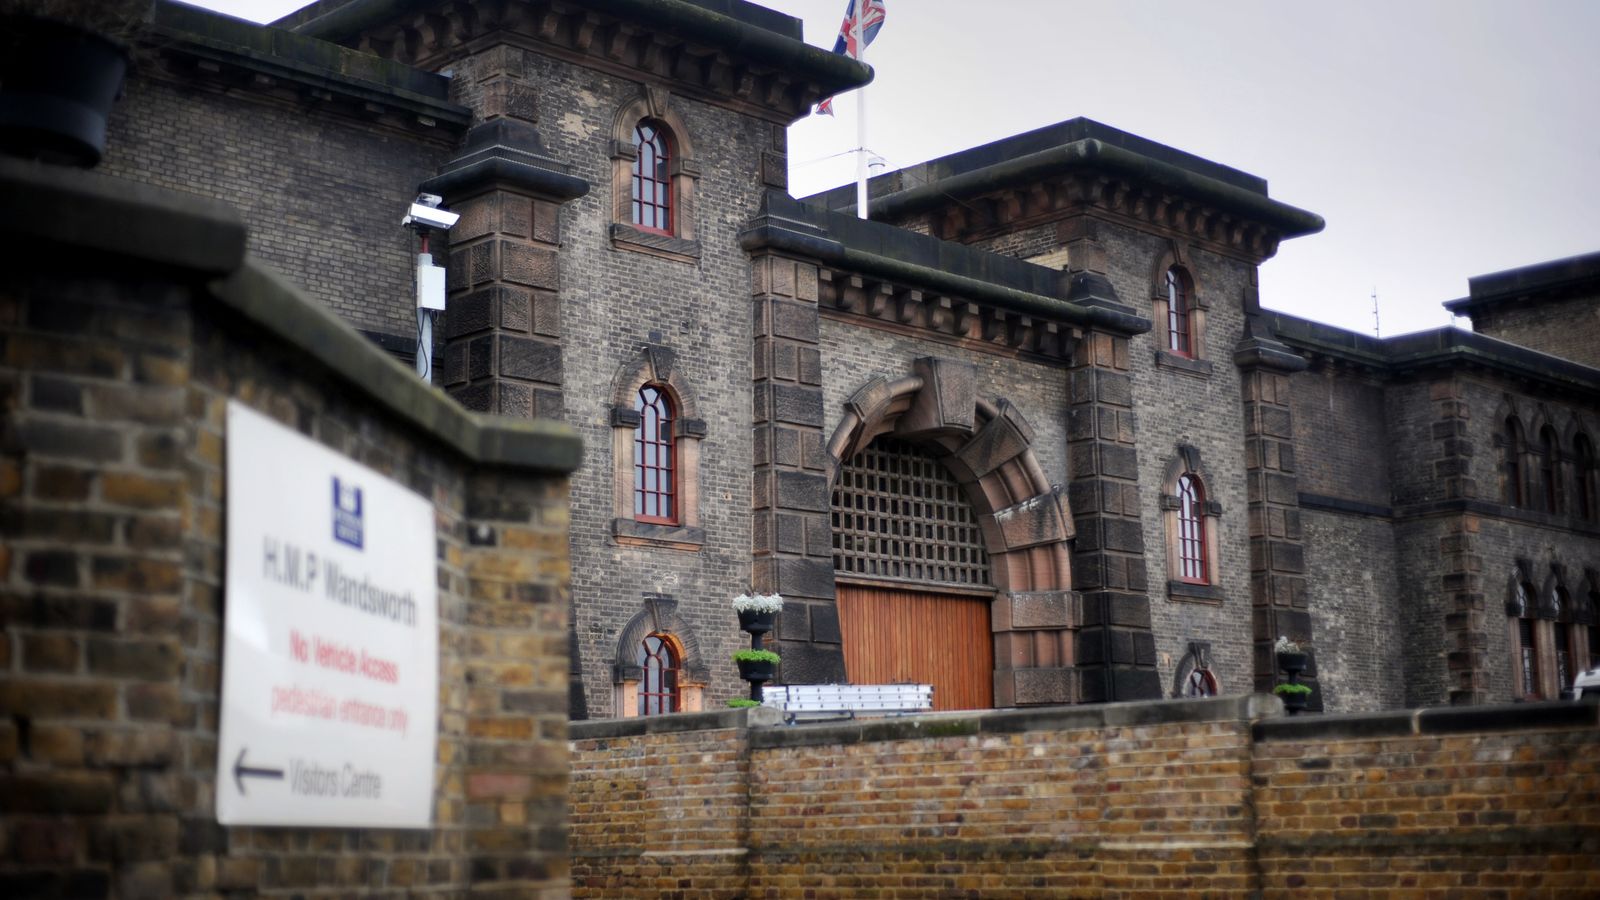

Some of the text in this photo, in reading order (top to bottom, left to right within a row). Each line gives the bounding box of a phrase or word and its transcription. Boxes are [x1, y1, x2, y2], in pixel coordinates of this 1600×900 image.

[323, 557, 417, 628] Wandsworth
[289, 629, 399, 684] No Vehicle Access
[340, 699, 385, 728] entrance
[388, 707, 408, 738] only
[289, 758, 382, 799] Visitors Centre
